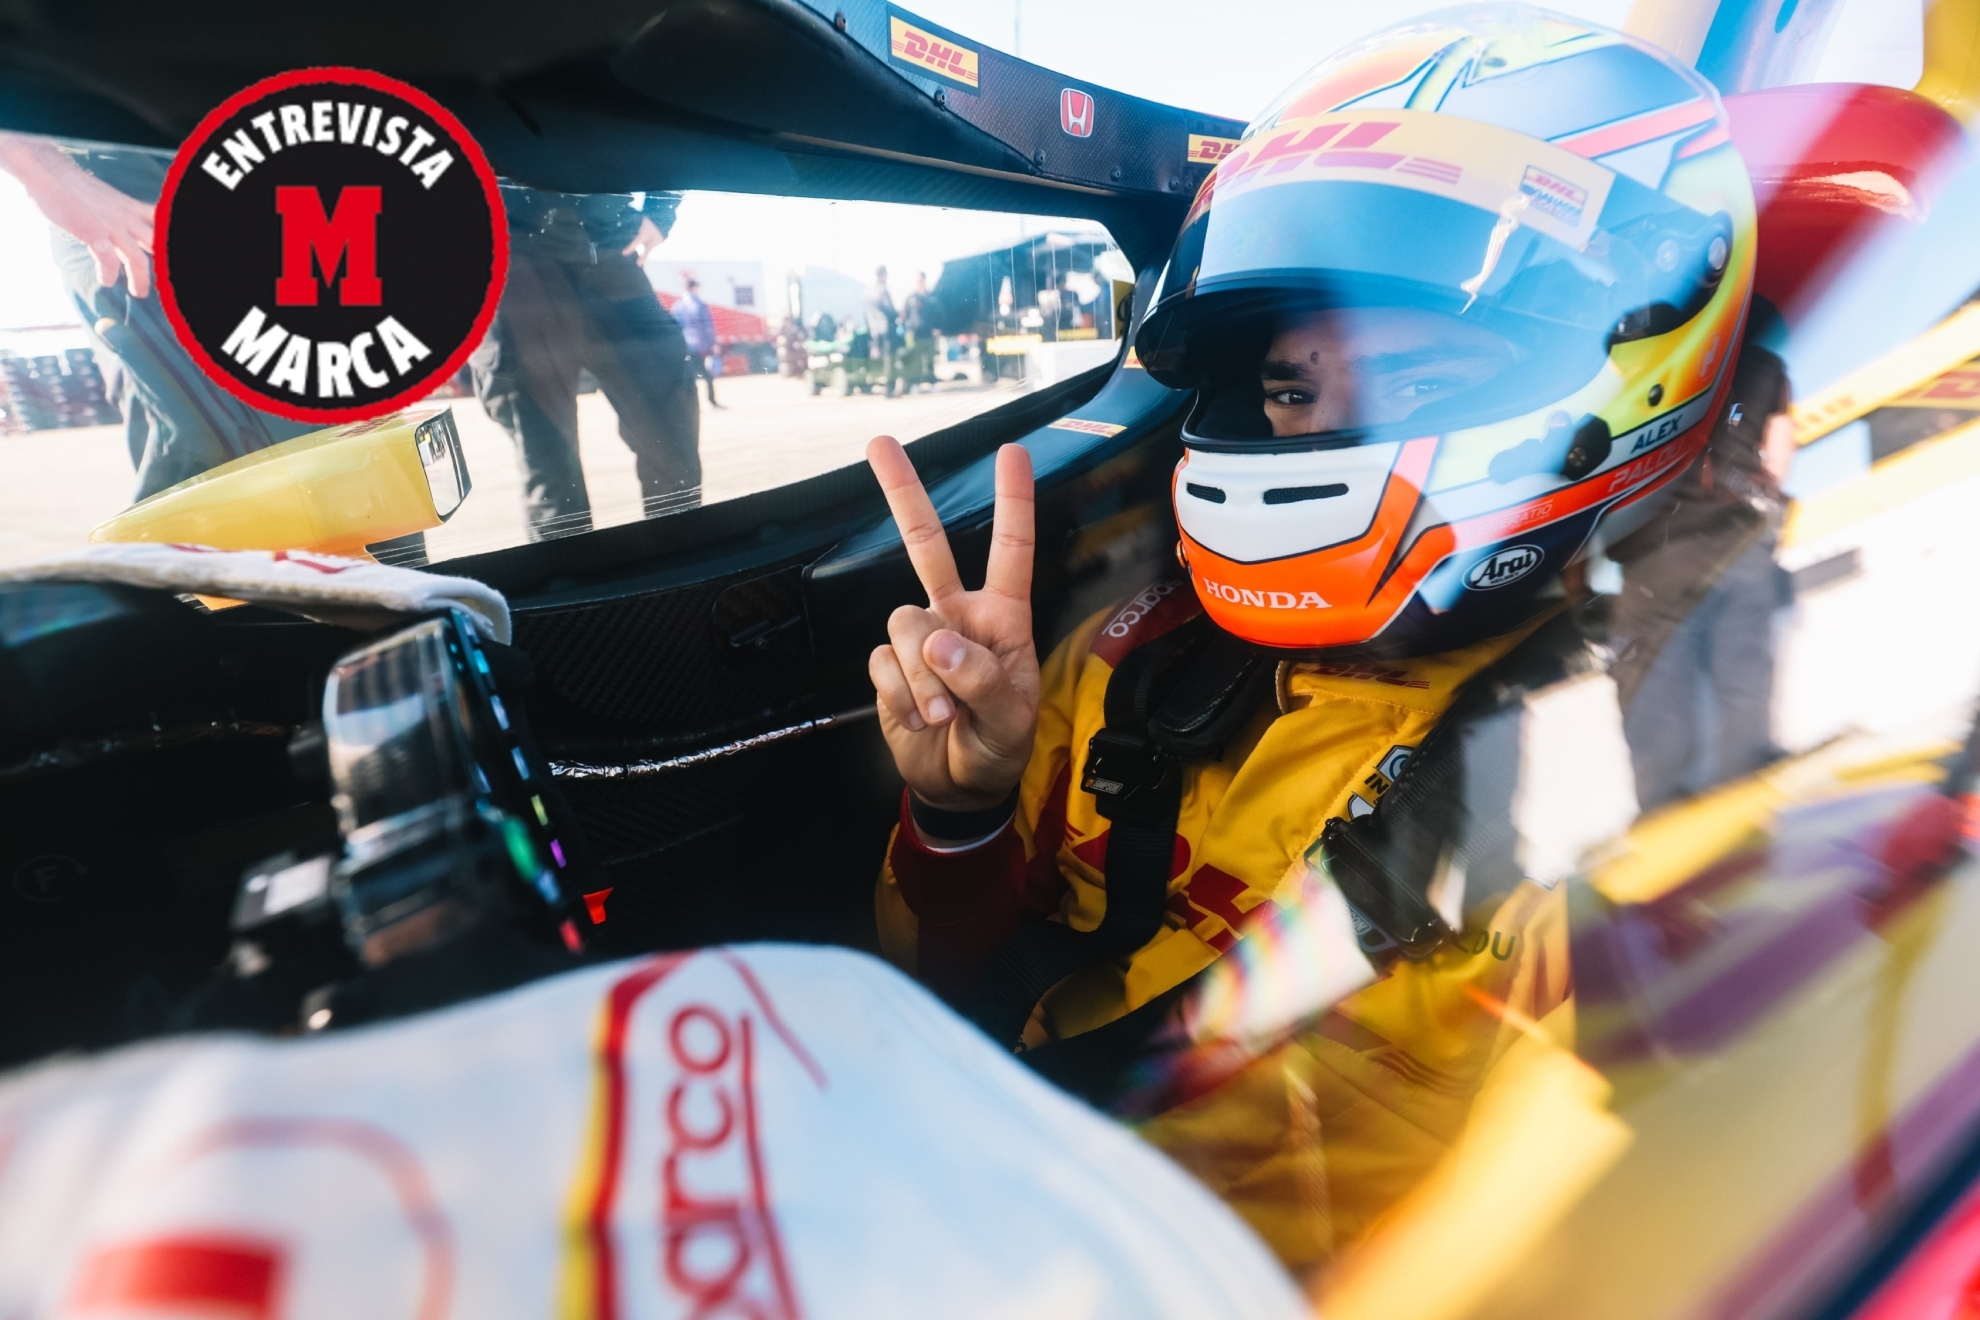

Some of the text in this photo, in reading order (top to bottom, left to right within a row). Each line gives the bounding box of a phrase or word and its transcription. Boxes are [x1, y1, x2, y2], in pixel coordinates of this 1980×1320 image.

[903, 30, 969, 77] DHL
[1199, 139, 1243, 161] DH
[1062, 419, 1113, 433] DHL
[1629, 413, 1683, 455] ALEX
[1471, 547, 1536, 587] Arai
[1108, 579, 1184, 638] sparco
[1202, 577, 1333, 610] HONDA
